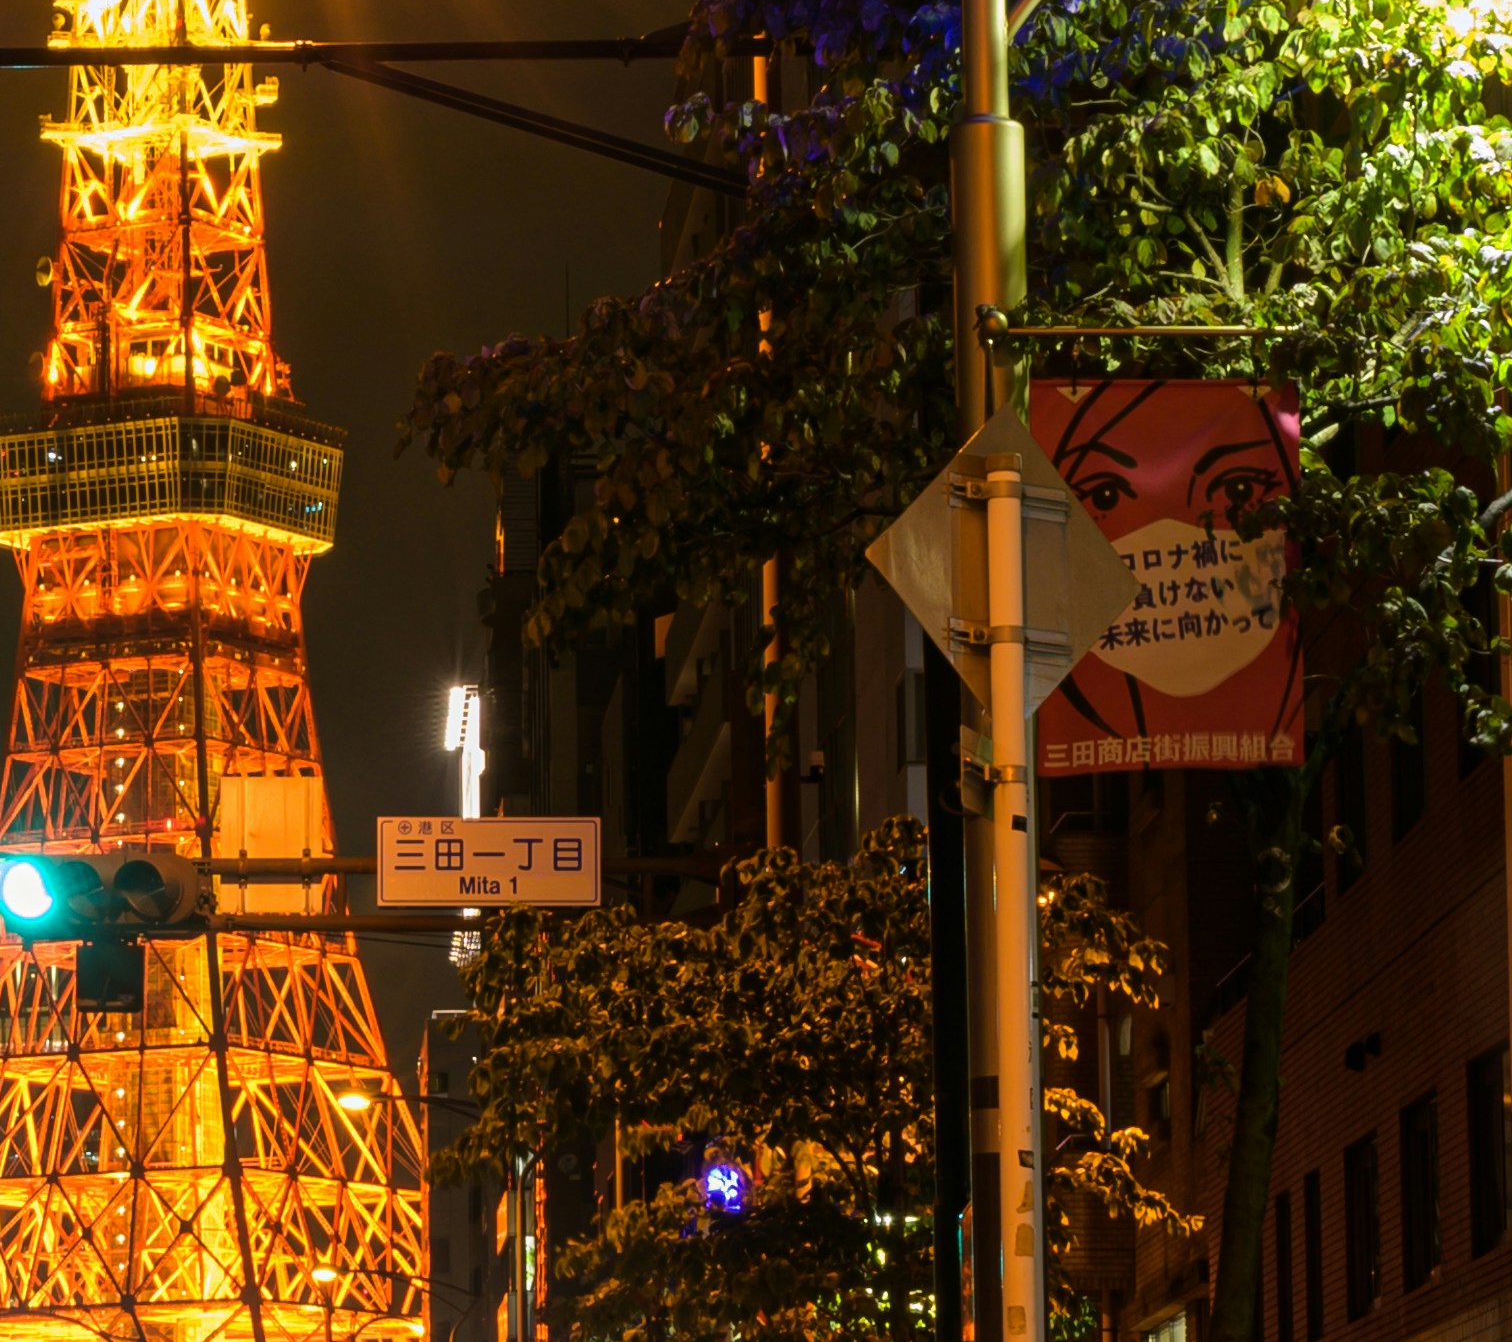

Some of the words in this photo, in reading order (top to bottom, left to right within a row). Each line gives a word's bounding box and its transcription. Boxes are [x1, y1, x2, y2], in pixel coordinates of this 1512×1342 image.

[1131, 575, 1235, 611] 負けない
[1098, 604, 1275, 652] 未来に向かって
[1043, 730, 1297, 769] 三田商店街振興組合
[417, 820, 455, 835] 港区
[394, 838, 582, 872] 三田一丁目
[459, 876, 501, 895] Mita
[509, 876, 518, 895] 1
